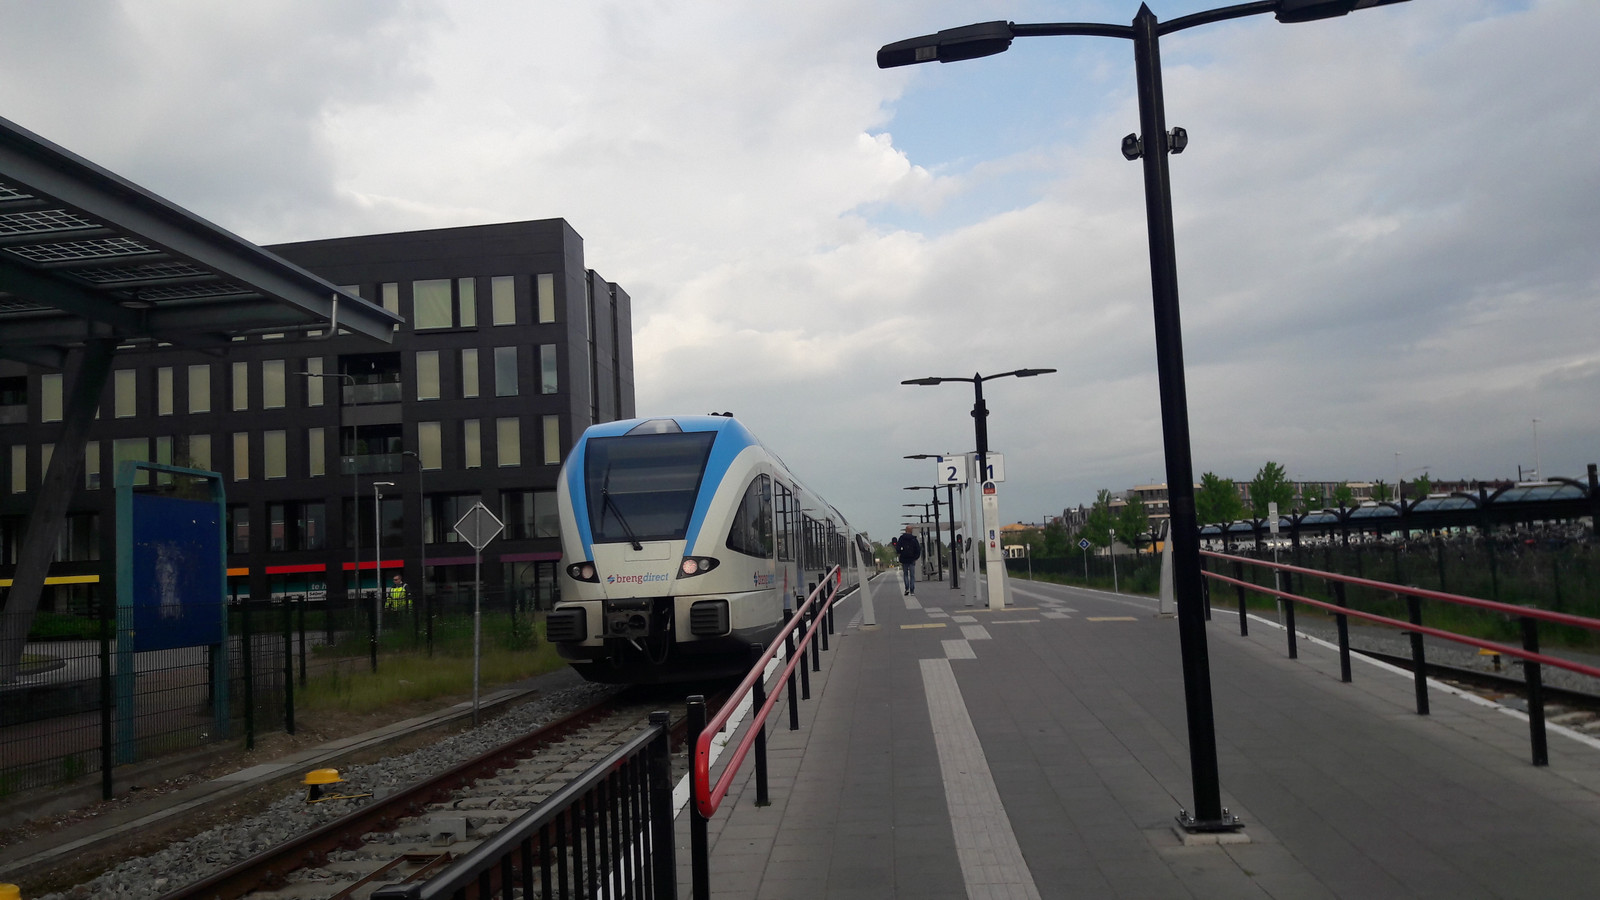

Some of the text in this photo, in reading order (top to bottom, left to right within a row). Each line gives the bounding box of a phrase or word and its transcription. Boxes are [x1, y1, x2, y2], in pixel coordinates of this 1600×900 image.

[947, 466, 958, 481] 2
[986, 464, 994, 479] 1
[616, 572, 669, 584] brengdirect
